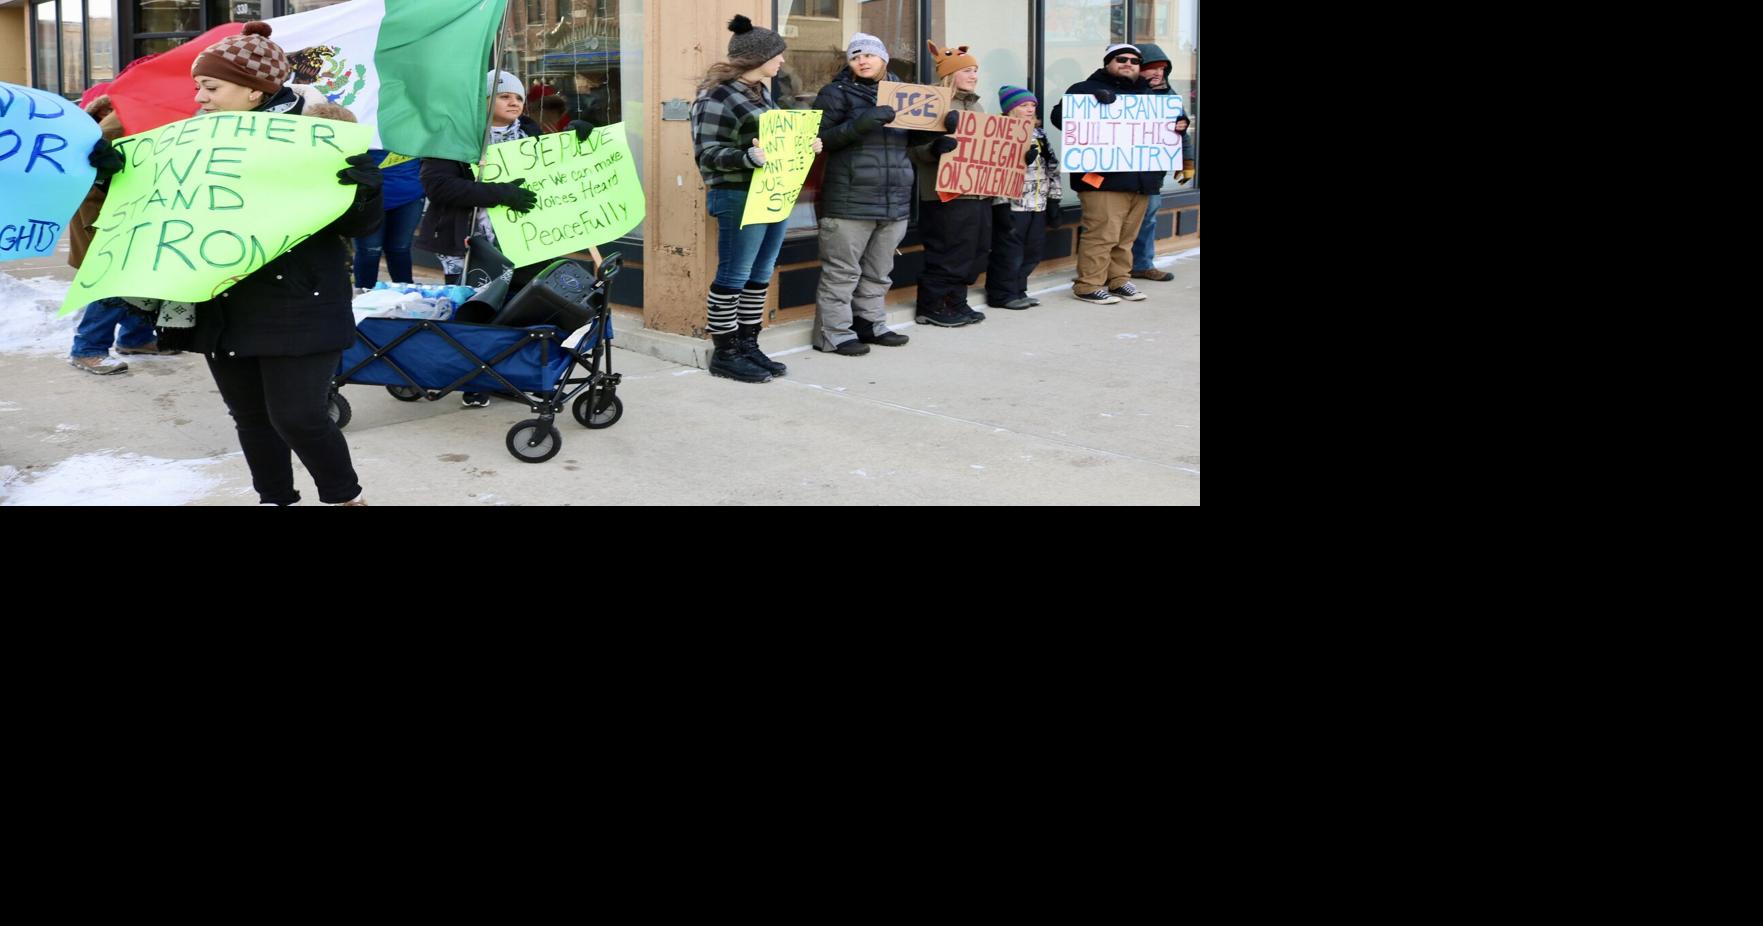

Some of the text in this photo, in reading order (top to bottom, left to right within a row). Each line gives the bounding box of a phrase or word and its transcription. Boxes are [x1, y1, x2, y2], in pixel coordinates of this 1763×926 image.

[895, 91, 938, 118] ICE
[1063, 94, 1183, 120] IMMIGRANTS
[113, 114, 344, 173] TOGETHER
[957, 111, 1031, 143] NO ONE'S
[1064, 121, 1181, 146] BUILT THIS
[153, 146, 247, 186] WE
[549, 171, 567, 186] We
[571, 167, 593, 181] can
[594, 151, 624, 173] make
[952, 136, 1026, 169] ILLEGAL
[1063, 145, 1182, 172] COUNTRY
[938, 162, 961, 190] ON
[960, 164, 1008, 196] STOLEN
[102, 184, 245, 232] STAND
[506, 169, 620, 224] Ou Voices Heard
[80, 218, 312, 288] STRON
